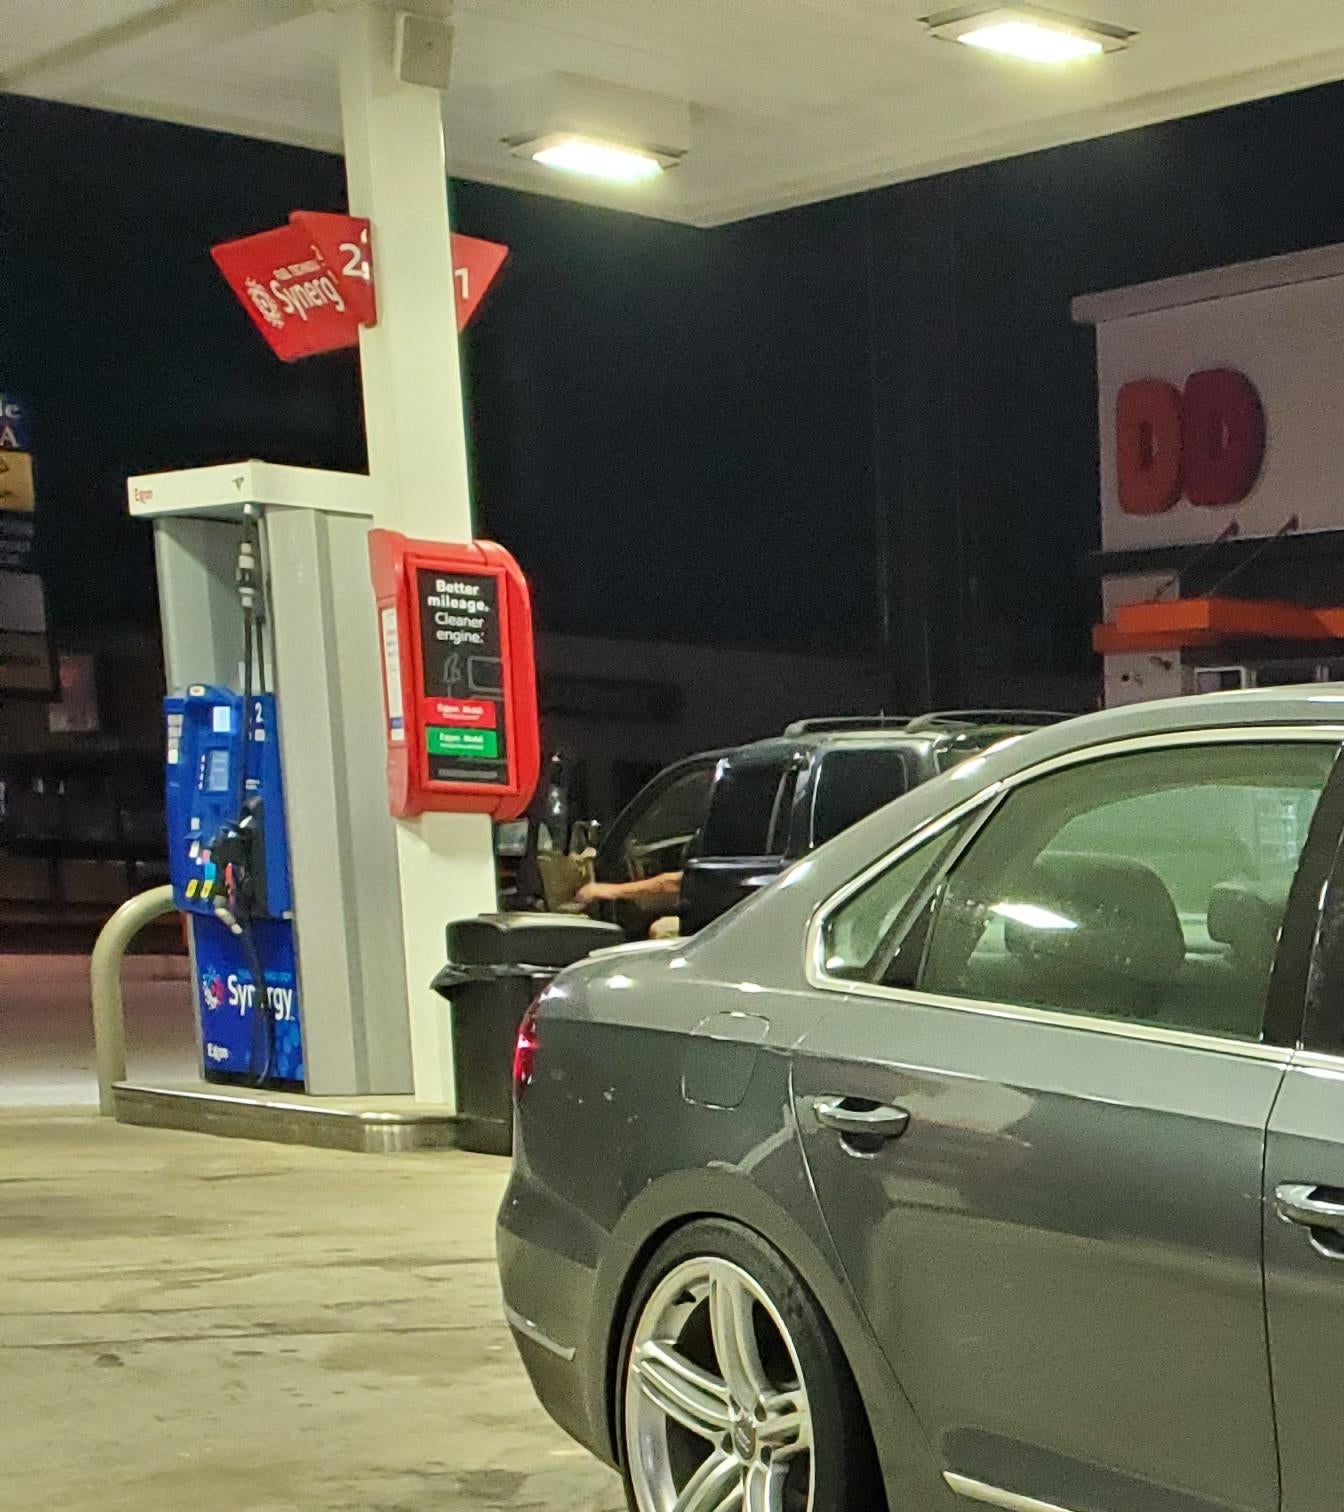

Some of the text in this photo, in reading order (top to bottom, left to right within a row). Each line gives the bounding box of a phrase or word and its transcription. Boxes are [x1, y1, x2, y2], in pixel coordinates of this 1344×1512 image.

[435, 579, 479, 596] Better
[434, 611, 484, 629] Cleaner
[227, 973, 293, 1021] Synrgy
